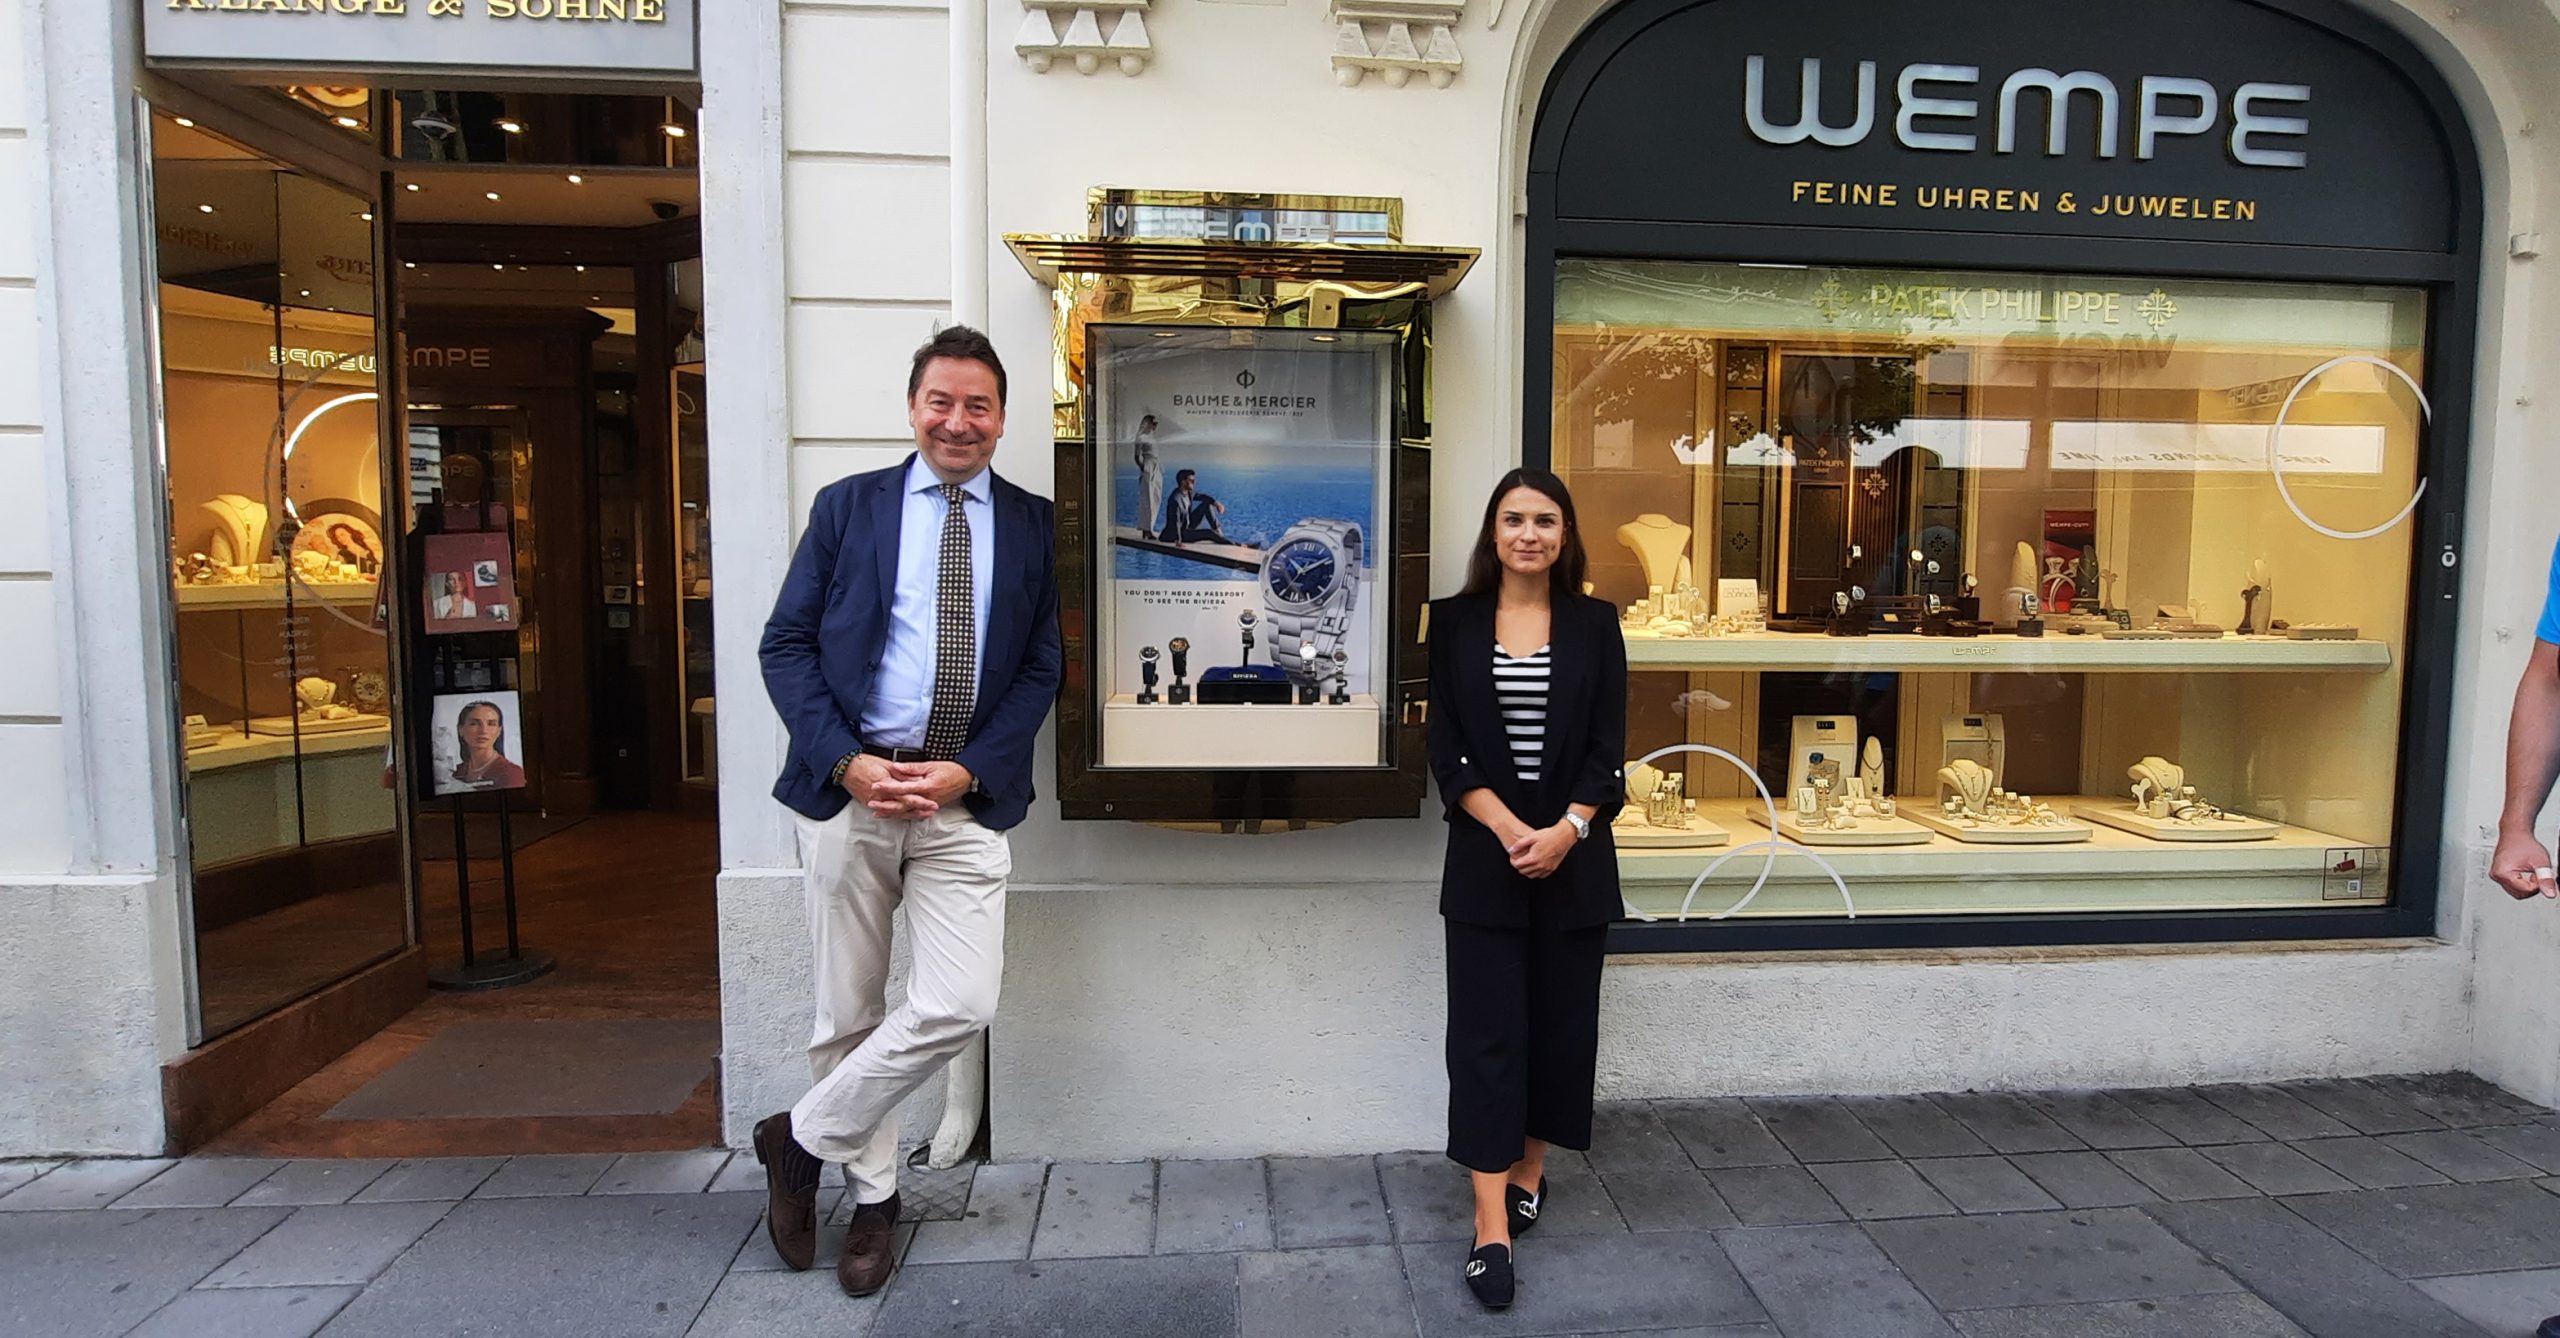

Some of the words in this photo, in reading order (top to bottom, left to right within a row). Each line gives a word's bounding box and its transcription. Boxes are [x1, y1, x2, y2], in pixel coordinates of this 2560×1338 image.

[427, 0, 463, 16] &
[1744, 55, 2311, 168] WEMPE
[1791, 181, 1898, 207] FEINE
[1916, 186, 2040, 213] UHREN
[2056, 191, 2078, 214] &
[2090, 195, 2257, 222] JUWELEN
[1870, 282, 1972, 319] PATEK
[1980, 287, 2121, 324] PHILIPPE
[404, 346, 491, 368] MPE
[1173, 394, 1230, 407] BAUME
[1233, 395, 1243, 408] &
[1245, 395, 1316, 408] MERCIER
